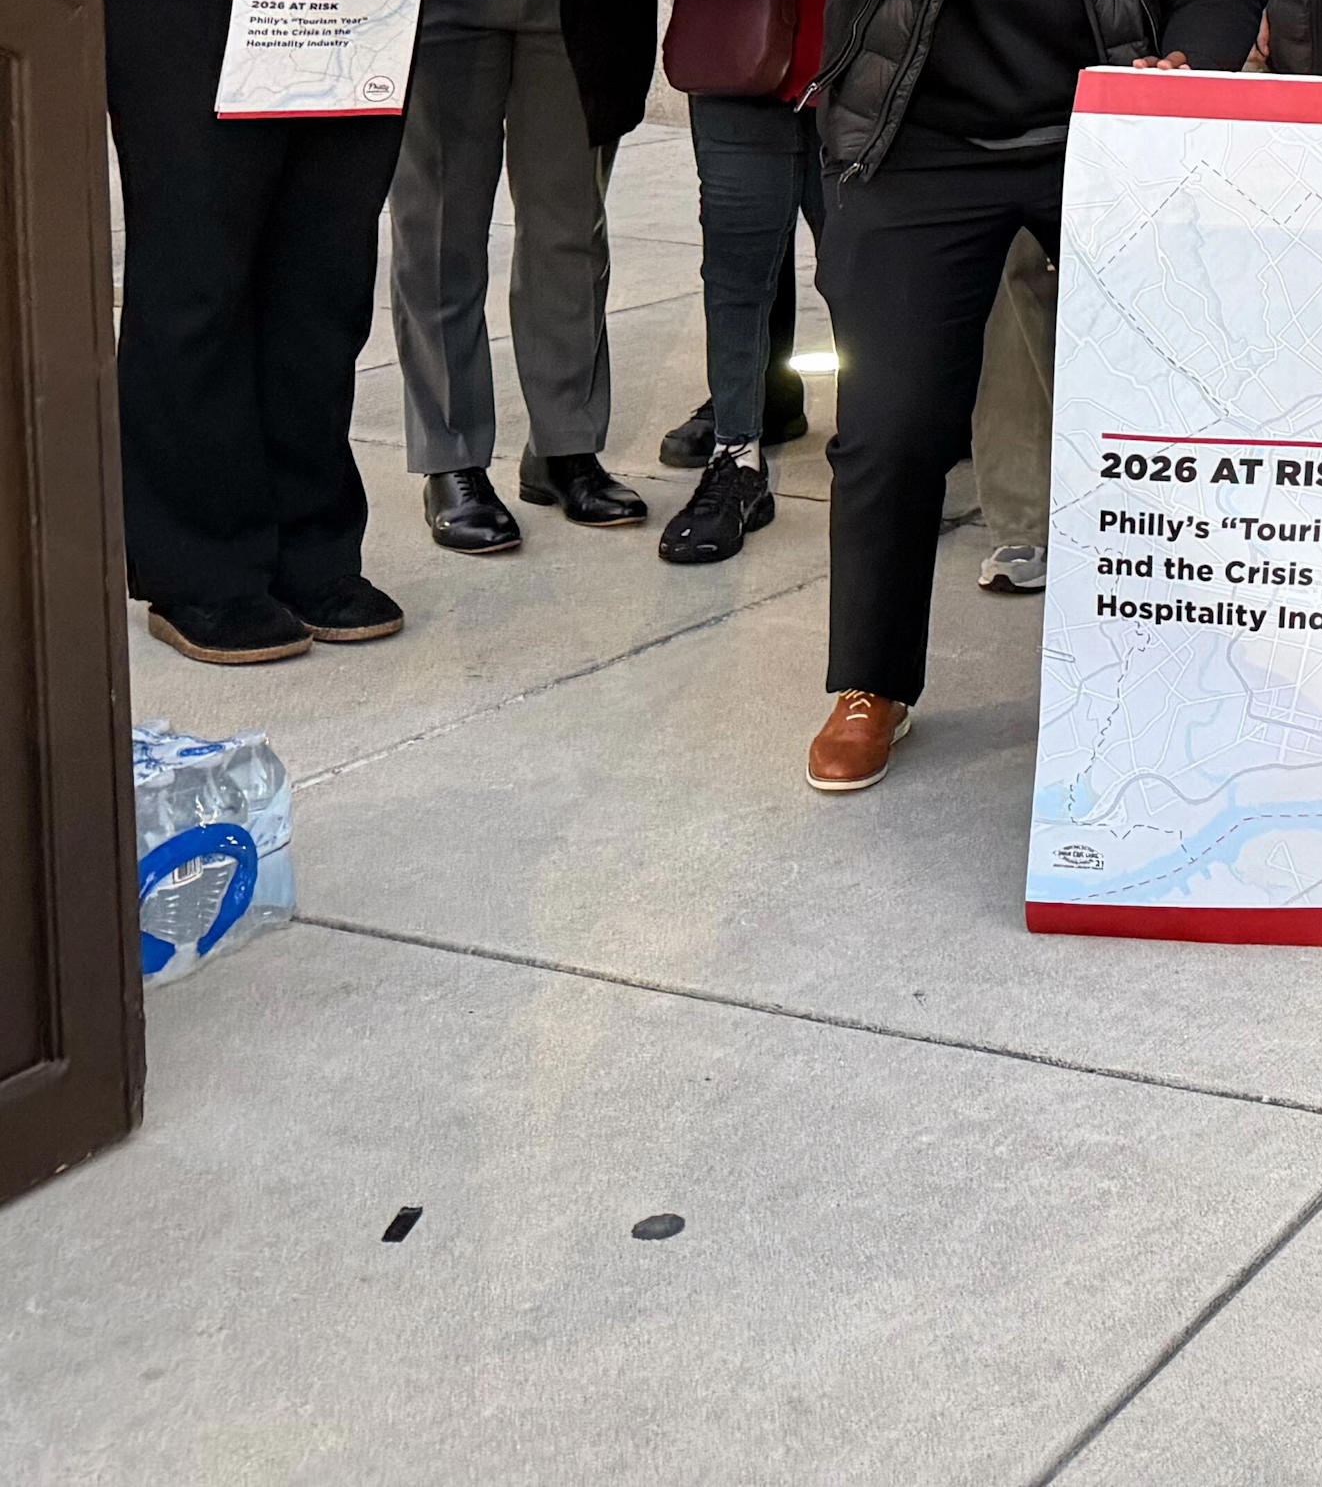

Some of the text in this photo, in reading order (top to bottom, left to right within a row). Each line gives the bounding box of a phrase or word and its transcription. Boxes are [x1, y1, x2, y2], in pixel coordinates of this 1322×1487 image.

[251, 0, 340, 11] 2026 AT RISK
[246, 39, 350, 49] Hospitality Industry
[248, 28, 268, 36] and
[292, 28, 319, 36] Crisis
[322, 28, 332, 36] in
[1100, 452, 1197, 483] 2026
[1209, 458, 1263, 485] AT
[1099, 510, 1210, 542] Philly’s
[1097, 555, 1153, 579] and
[1163, 556, 1214, 582] the
[1225, 560, 1313, 586] Crisis
[1096, 594, 1267, 631] Hospitality
